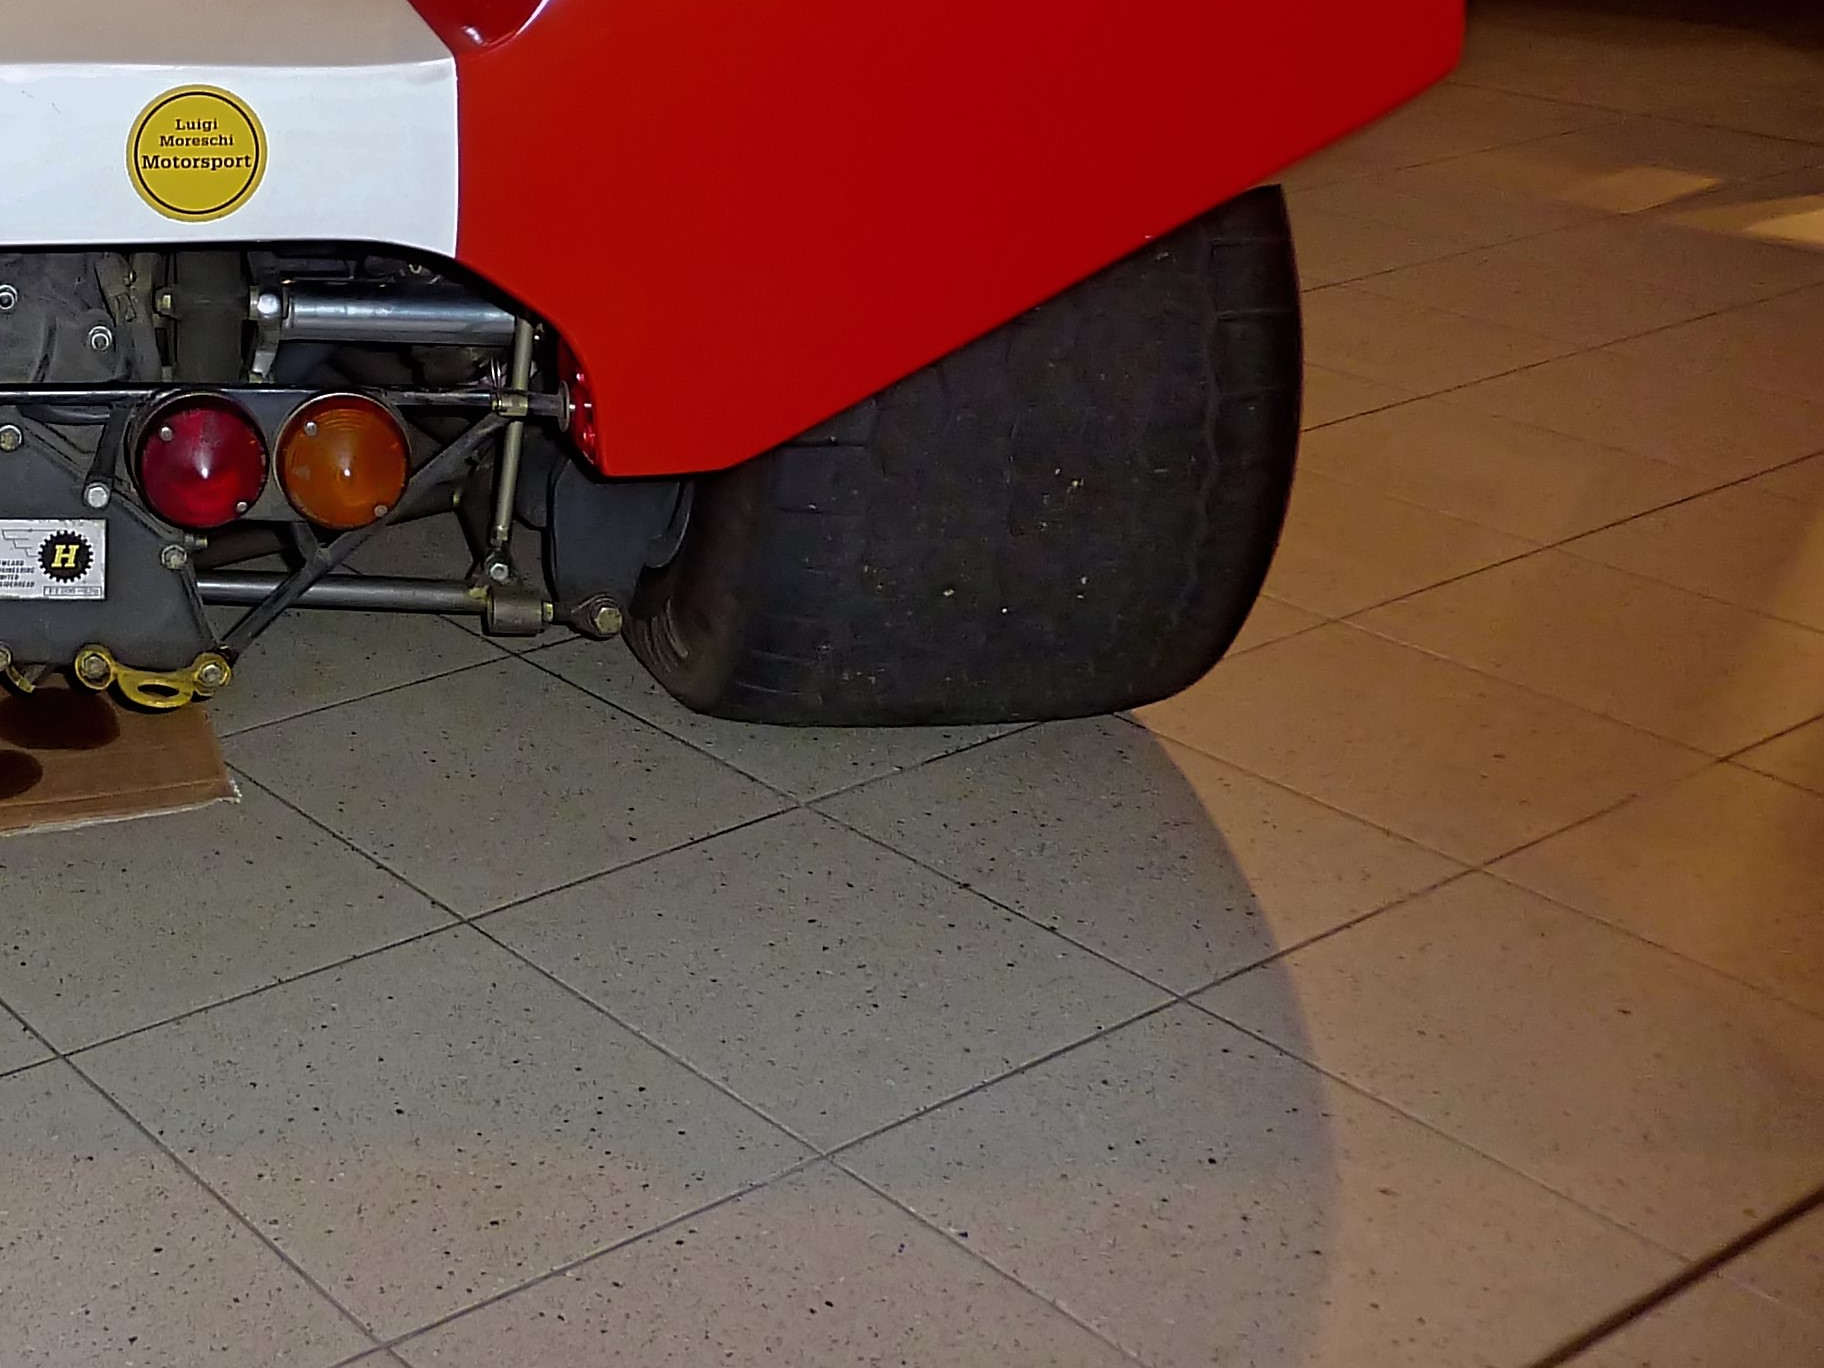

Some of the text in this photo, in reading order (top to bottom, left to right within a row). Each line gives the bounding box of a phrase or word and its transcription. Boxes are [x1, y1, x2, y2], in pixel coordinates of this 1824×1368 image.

[175, 118, 218, 132] Luigi
[159, 134, 234, 147] Moreschi
[141, 154, 252, 171] Motorsport
[50, 544, 80, 568] H
